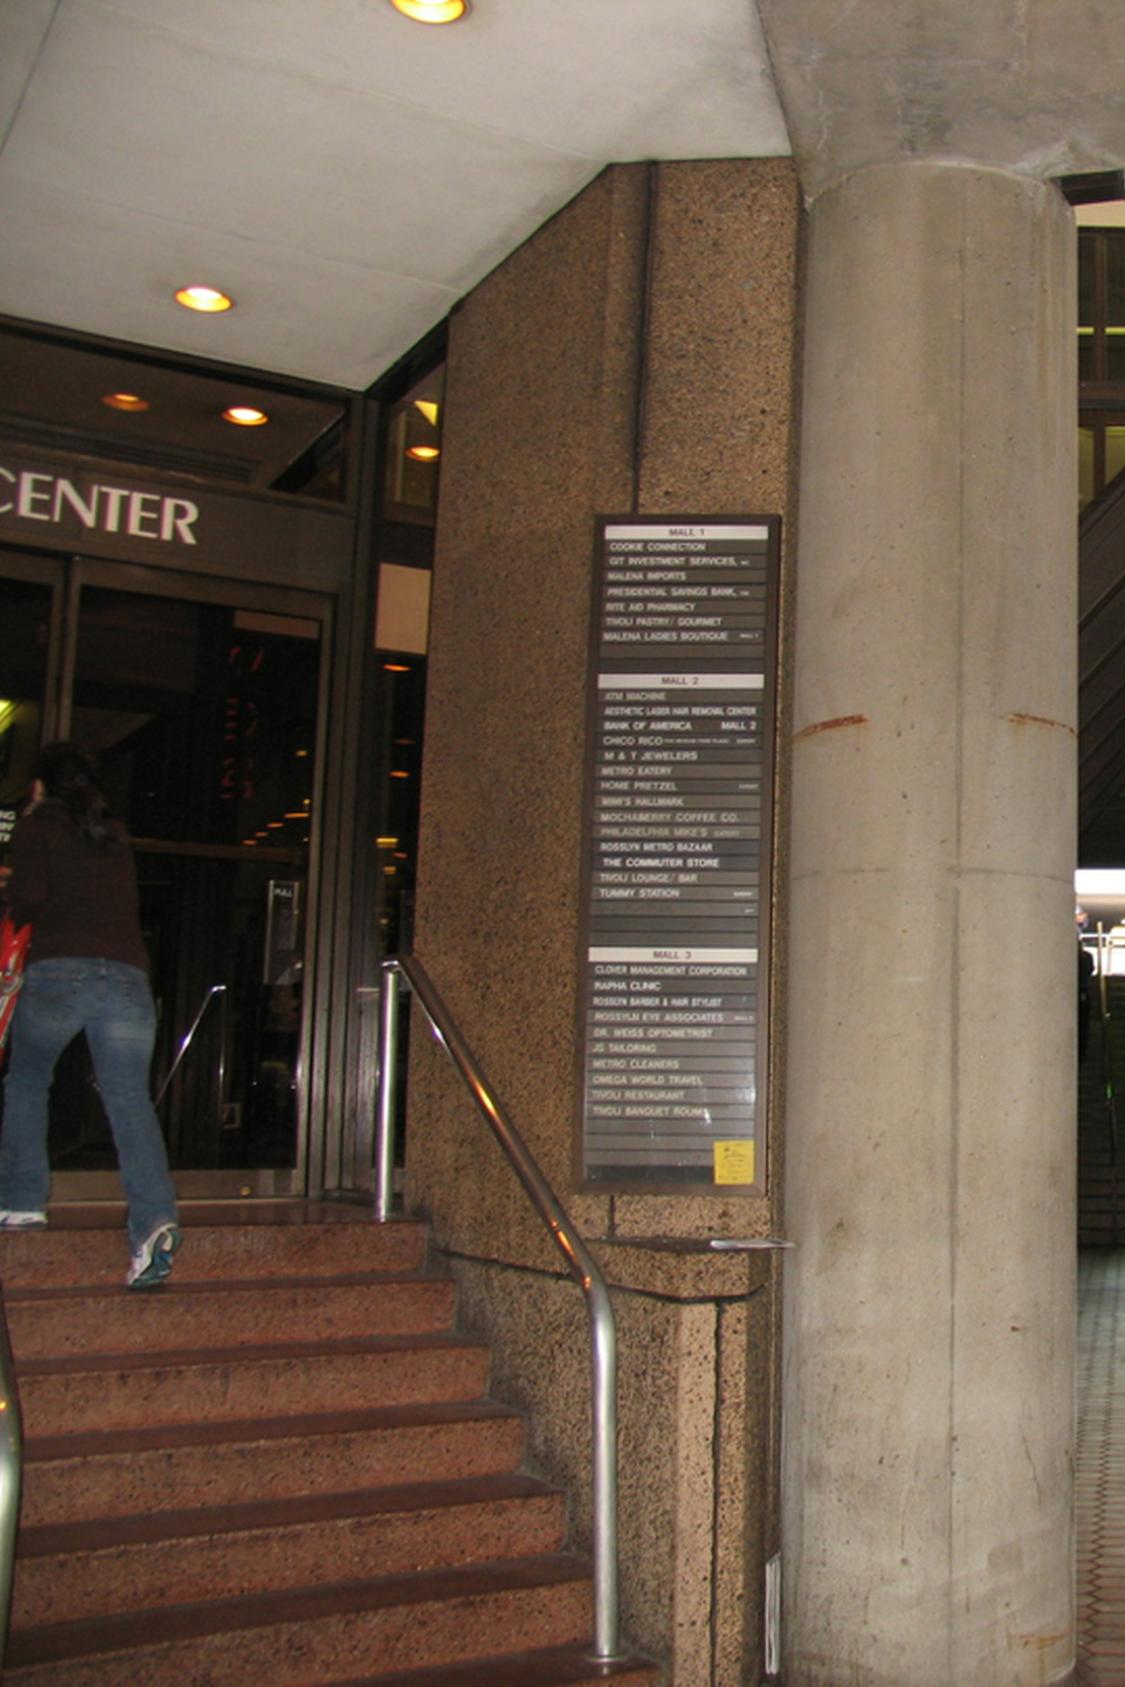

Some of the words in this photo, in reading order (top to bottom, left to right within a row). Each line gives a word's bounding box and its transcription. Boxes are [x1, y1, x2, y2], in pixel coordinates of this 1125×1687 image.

[669, 528, 694, 536] MALL
[609, 542, 643, 551] COOKIE
[647, 542, 706, 551] CONNECTION
[629, 557, 685, 566] INVESTMENT
[689, 557, 738, 566] SERVICES,
[607, 571, 643, 581] MALENA
[647, 571, 686, 581] IMPORTS
[607, 587, 666, 596] PRESIDENTIAL
[671, 587, 708, 596] SAVINGS
[711, 587, 737, 596] BANK,
[605, 602, 625, 612] RITE
[629, 602, 643, 612] AID
[647, 602, 696, 612] PHARMACY
[606, 617, 633, 626] TIVOLI
[678, 617, 722, 626] GOURMET
[603, 631, 641, 641] MALENA
[644, 631, 678, 641] LADIES
[681, 631, 728, 641] BOUTIQUE
[662, 677, 687, 685] MALL
[692, 677, 699, 685] 2
[605, 692, 623, 700] ATM
[627, 692, 666, 700] MACHINE
[646, 707, 670, 716] LASER
[672, 707, 689, 716] HAIR
[691, 707, 724, 716] REMOVAL
[727, 707, 756, 716] CENTER
[604, 722, 629, 731] BANK
[633, 722, 646, 731] OF
[650, 722, 692, 731] AMERICA
[721, 722, 745, 731] MALL
[750, 722, 756, 731] 2
[603, 736, 635, 745] CHICO
[639, 736, 662, 745] RICO
[604, 751, 614, 760] M
[631, 751, 637, 760] T
[641, 751, 698, 760] JEWELERS
[601, 766, 635, 776] METRO
[638, 766, 672, 776] EATERY
[601, 781, 629, 790] HOME
[634, 781, 678, 790] PRETZEL
[635, 796, 684, 806] HALLMARK
[601, 813, 671, 822] MOCHABERRY
[675, 813, 716, 822] COFFEE
[721, 813, 739, 822] CO.
[600, 828, 669, 838] PHILADELPHIA
[601, 843, 641, 851] ROSSLYN
[643, 843, 674, 851] METRO
[677, 843, 713, 851] BAZAAR
[604, 858, 621, 868] THE
[625, 858, 683, 868] COMMUTER
[687, 858, 719, 868] STORE
[600, 872, 628, 883] TIVOLI
[678, 872, 698, 883] BAR
[600, 888, 634, 898] TUMMY
[638, 888, 680, 898] STATION
[653, 950, 680, 959] MALL
[595, 965, 627, 975] CLOVER
[630, 965, 686, 975] MANAGEMENT
[689, 965, 747, 975] CORPORATION
[594, 981, 627, 991] RAPHA
[630, 981, 661, 991] CLINIC
[593, 997, 627, 1007] ROSSLYN
[630, 997, 660, 1007] BARBER
[671, 997, 689, 1007] HAIR
[692, 997, 723, 1007] STYLIST
[642, 1012, 660, 1022] EYE
[664, 1012, 724, 1022] ASSOCIATES
[614, 1028, 644, 1037] WEISS
[648, 1028, 713, 1037] OPTOMETRIST
[609, 1043, 657, 1053] TAILORING
[593, 1059, 625, 1069] METRO
[630, 1059, 679, 1069] CLEANERS
[593, 1075, 627, 1085] OMEGA
[631, 1075, 665, 1085] WORLD
[669, 1075, 703, 1085] TRAVEL
[592, 1090, 621, 1100] TIVOLI
[624, 1090, 685, 1100] RESTAURANT
[592, 1106, 621, 1116] TIVOLI
[625, 1106, 669, 1116] BANQUET
